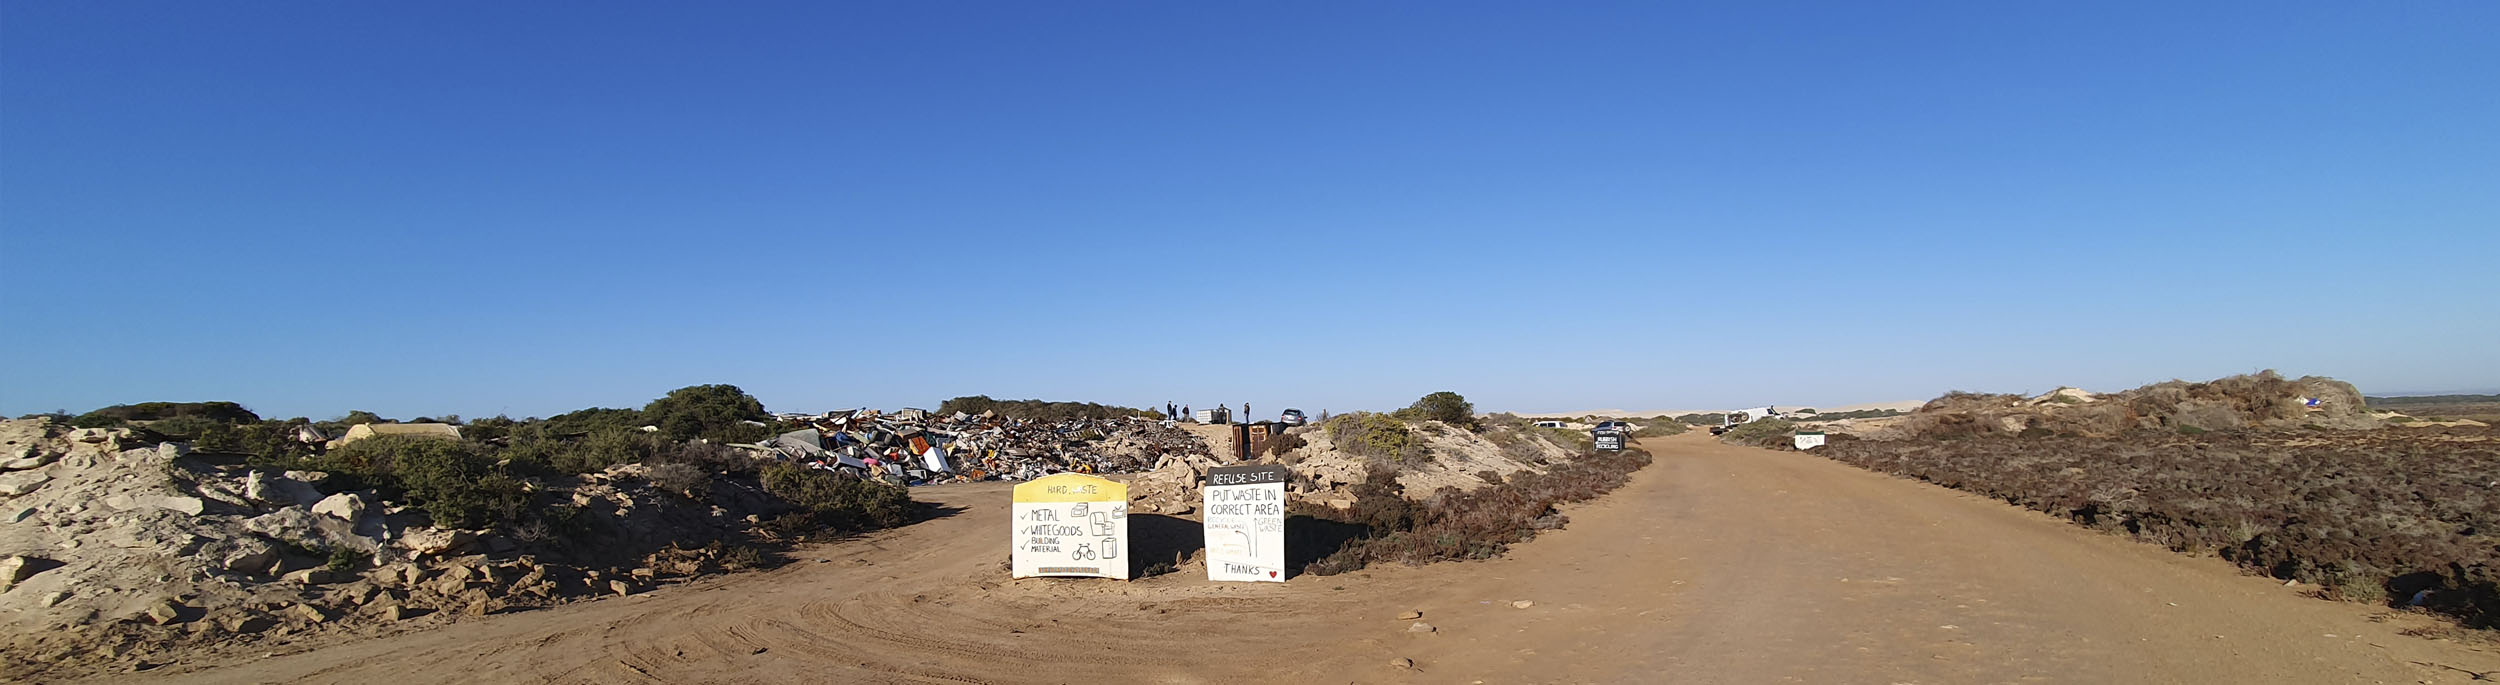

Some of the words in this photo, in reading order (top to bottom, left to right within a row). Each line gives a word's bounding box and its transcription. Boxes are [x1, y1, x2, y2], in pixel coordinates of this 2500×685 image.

[1213, 473, 1247, 484] REFUSE
[1250, 471, 1274, 481] SITE
[1047, 485, 1067, 494] HARD
[1213, 489, 1231, 502] PUT
[1232, 488, 1261, 500] WASTE
[1264, 489, 1276, 500] IN
[1211, 504, 1252, 515] CORRECT
[1254, 502, 1280, 515] AREA
[1031, 509, 1060, 521] METAL
[1258, 517, 1282, 525] GREEN
[1031, 525, 1083, 536] WHITEGOODS
[1259, 524, 1283, 532] WASTE
[1224, 563, 1260, 575] THANKS
